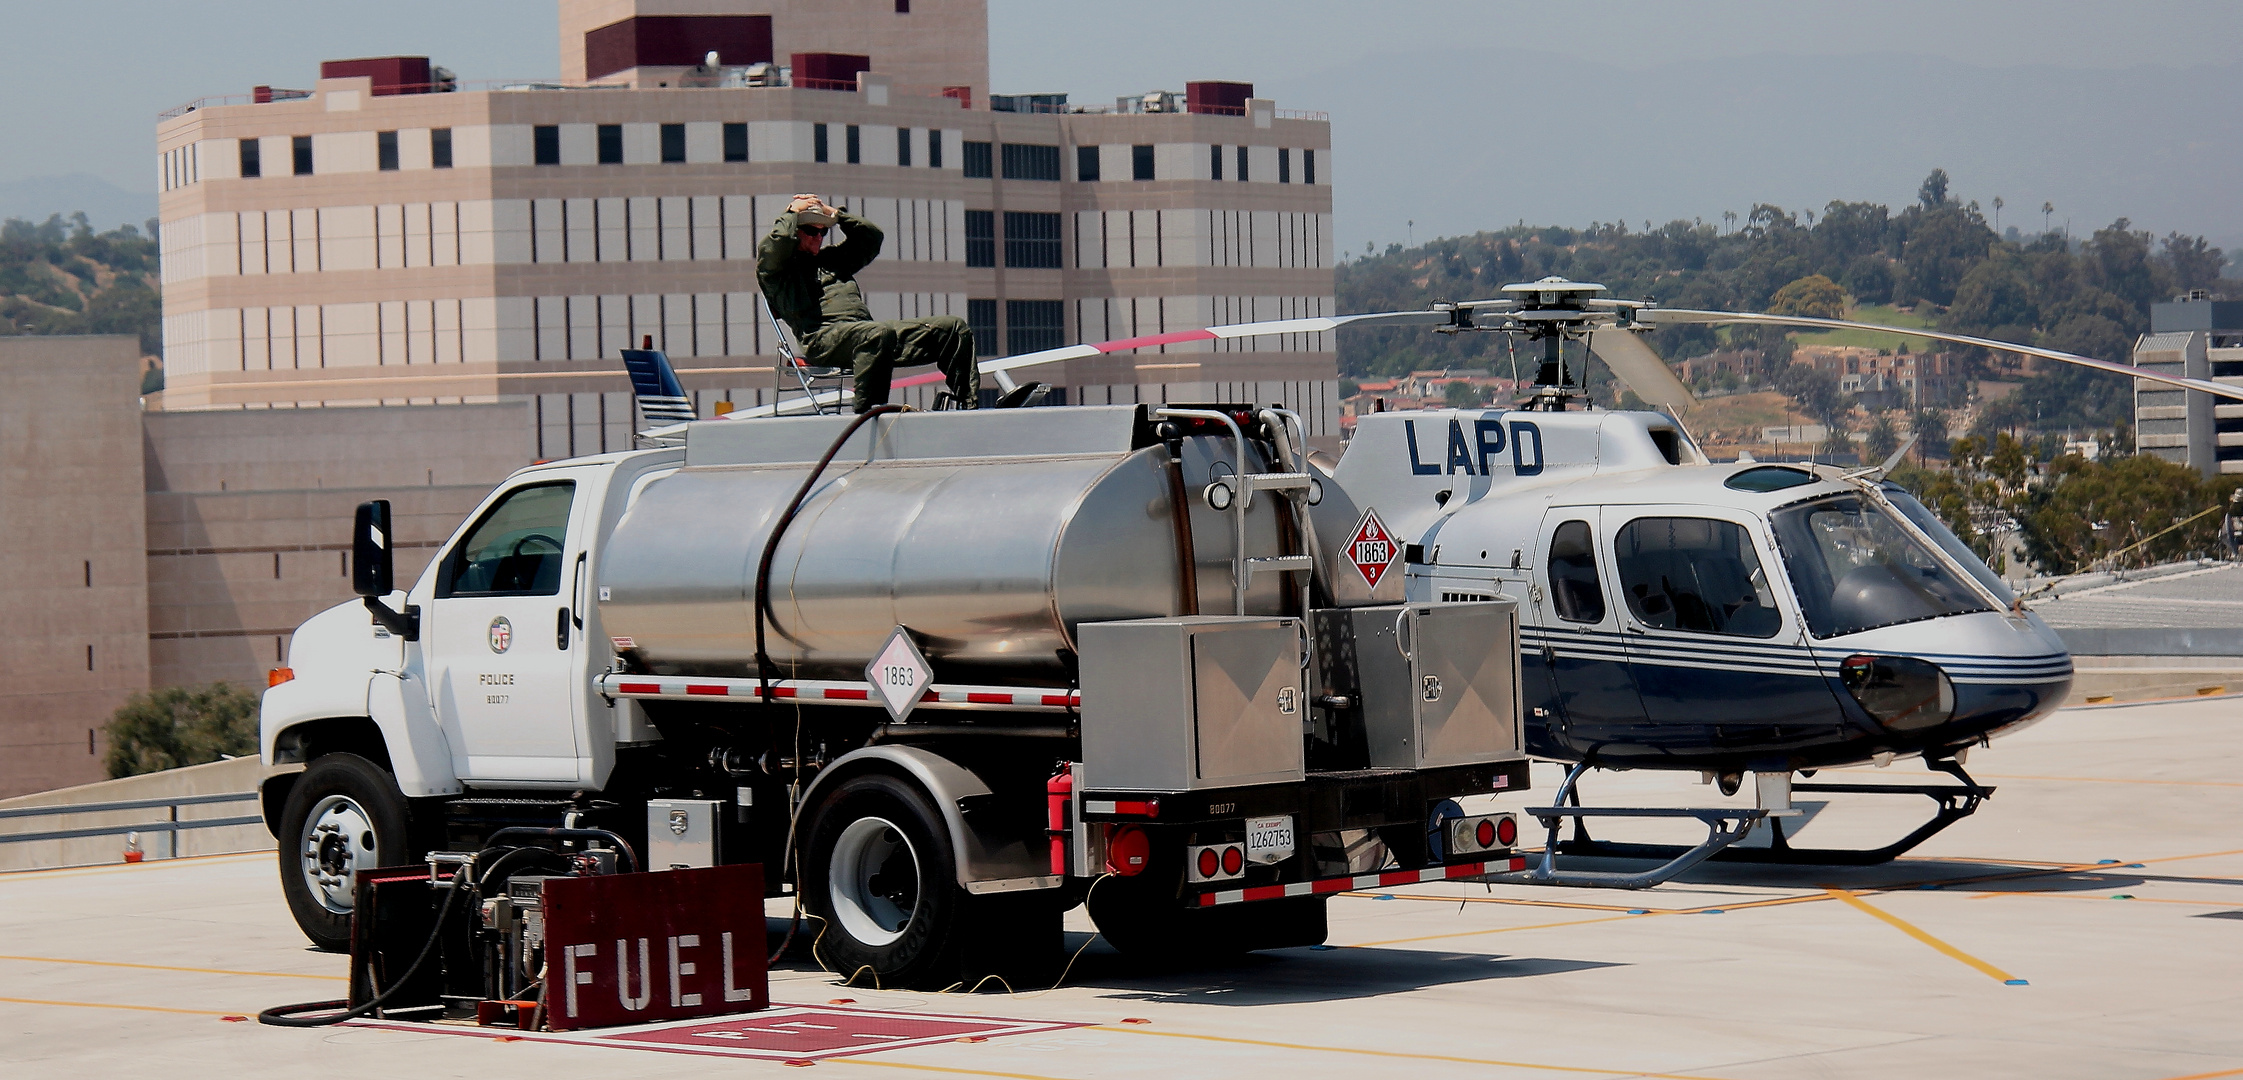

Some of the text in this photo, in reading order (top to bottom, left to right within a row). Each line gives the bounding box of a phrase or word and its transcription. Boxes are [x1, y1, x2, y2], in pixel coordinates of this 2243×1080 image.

[1404, 419, 1545, 476] LAPD
[1358, 542, 1387, 563] 1863
[1369, 567, 1376, 579] 3
[479, 674, 514, 686] POLICE
[884, 666, 914, 687] 1863
[486, 695, 509, 704] 80077
[1209, 803, 1236, 815] 80077
[1250, 829, 1291, 849] 1262753
[564, 931, 752, 1018] FUEL
[691, 1021, 837, 1040] PIT
